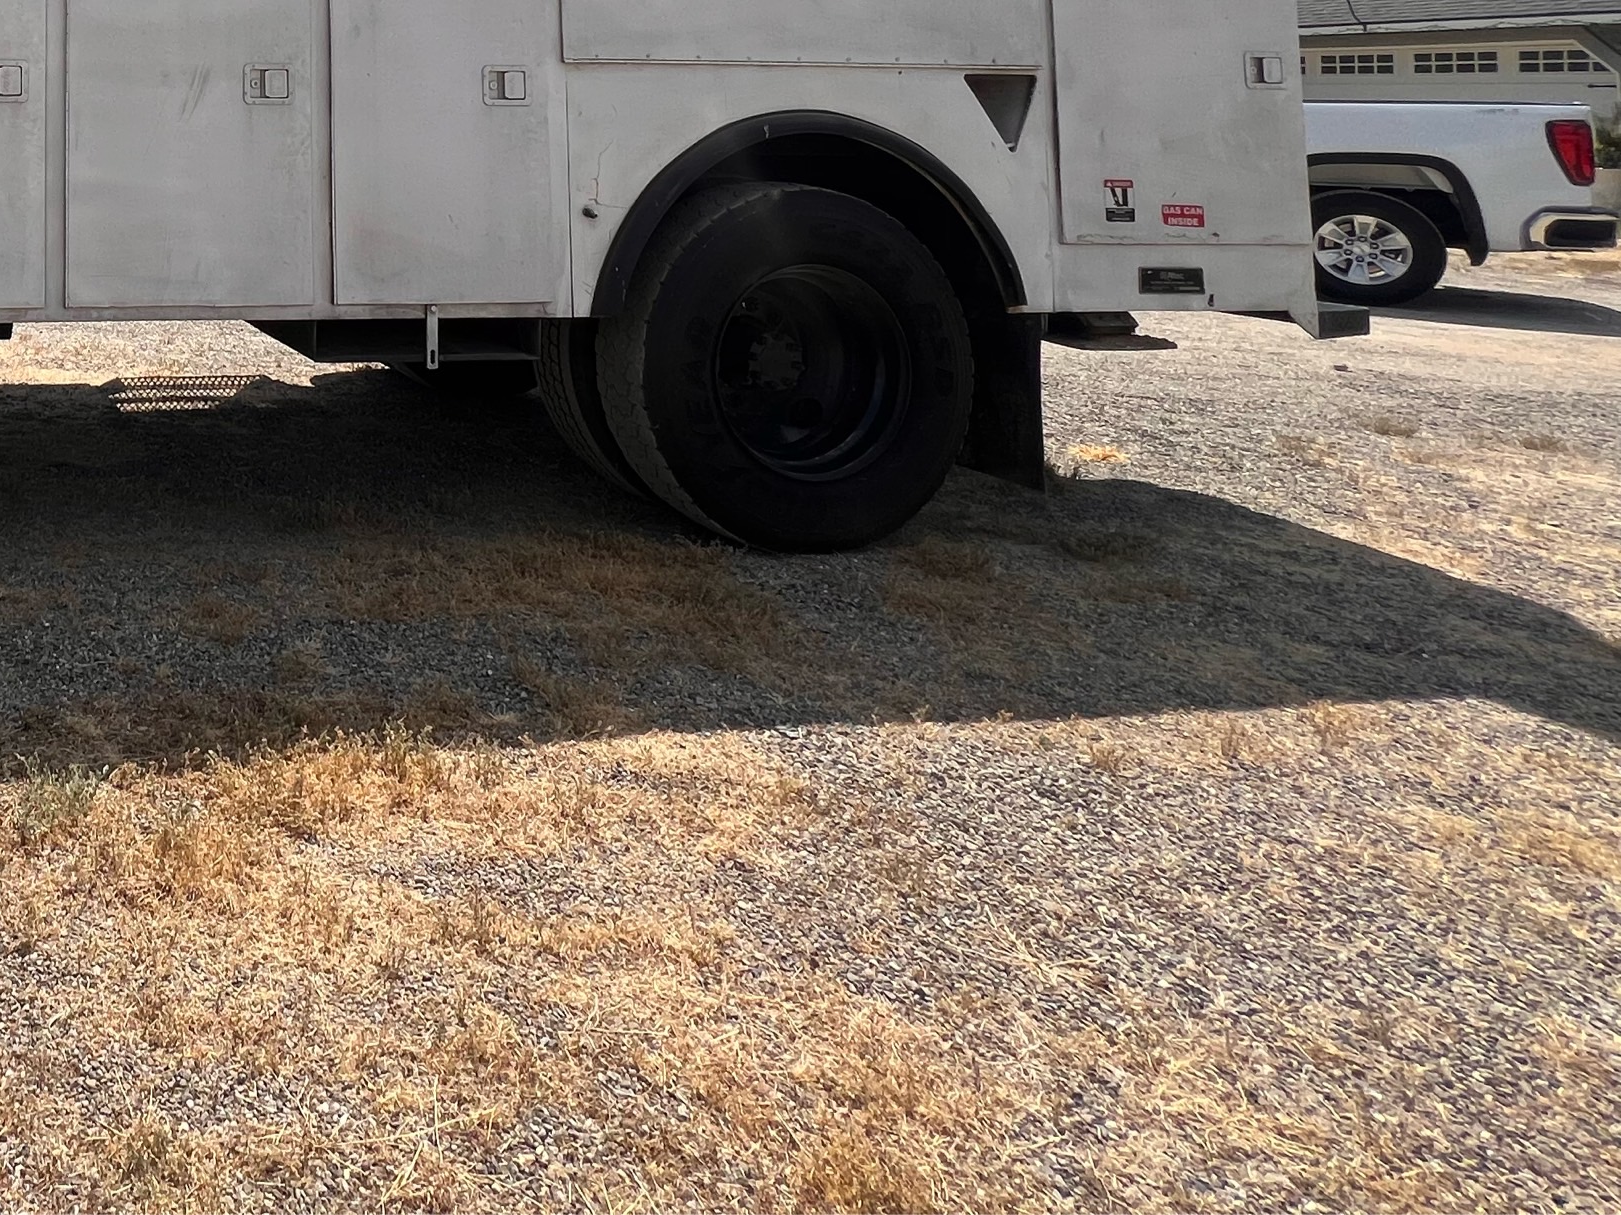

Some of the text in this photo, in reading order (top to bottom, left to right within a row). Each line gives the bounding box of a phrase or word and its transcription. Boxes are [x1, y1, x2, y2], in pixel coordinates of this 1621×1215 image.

[1163, 206, 1203, 215] GAS CAN
[1168, 217, 1199, 226] INSIDE
